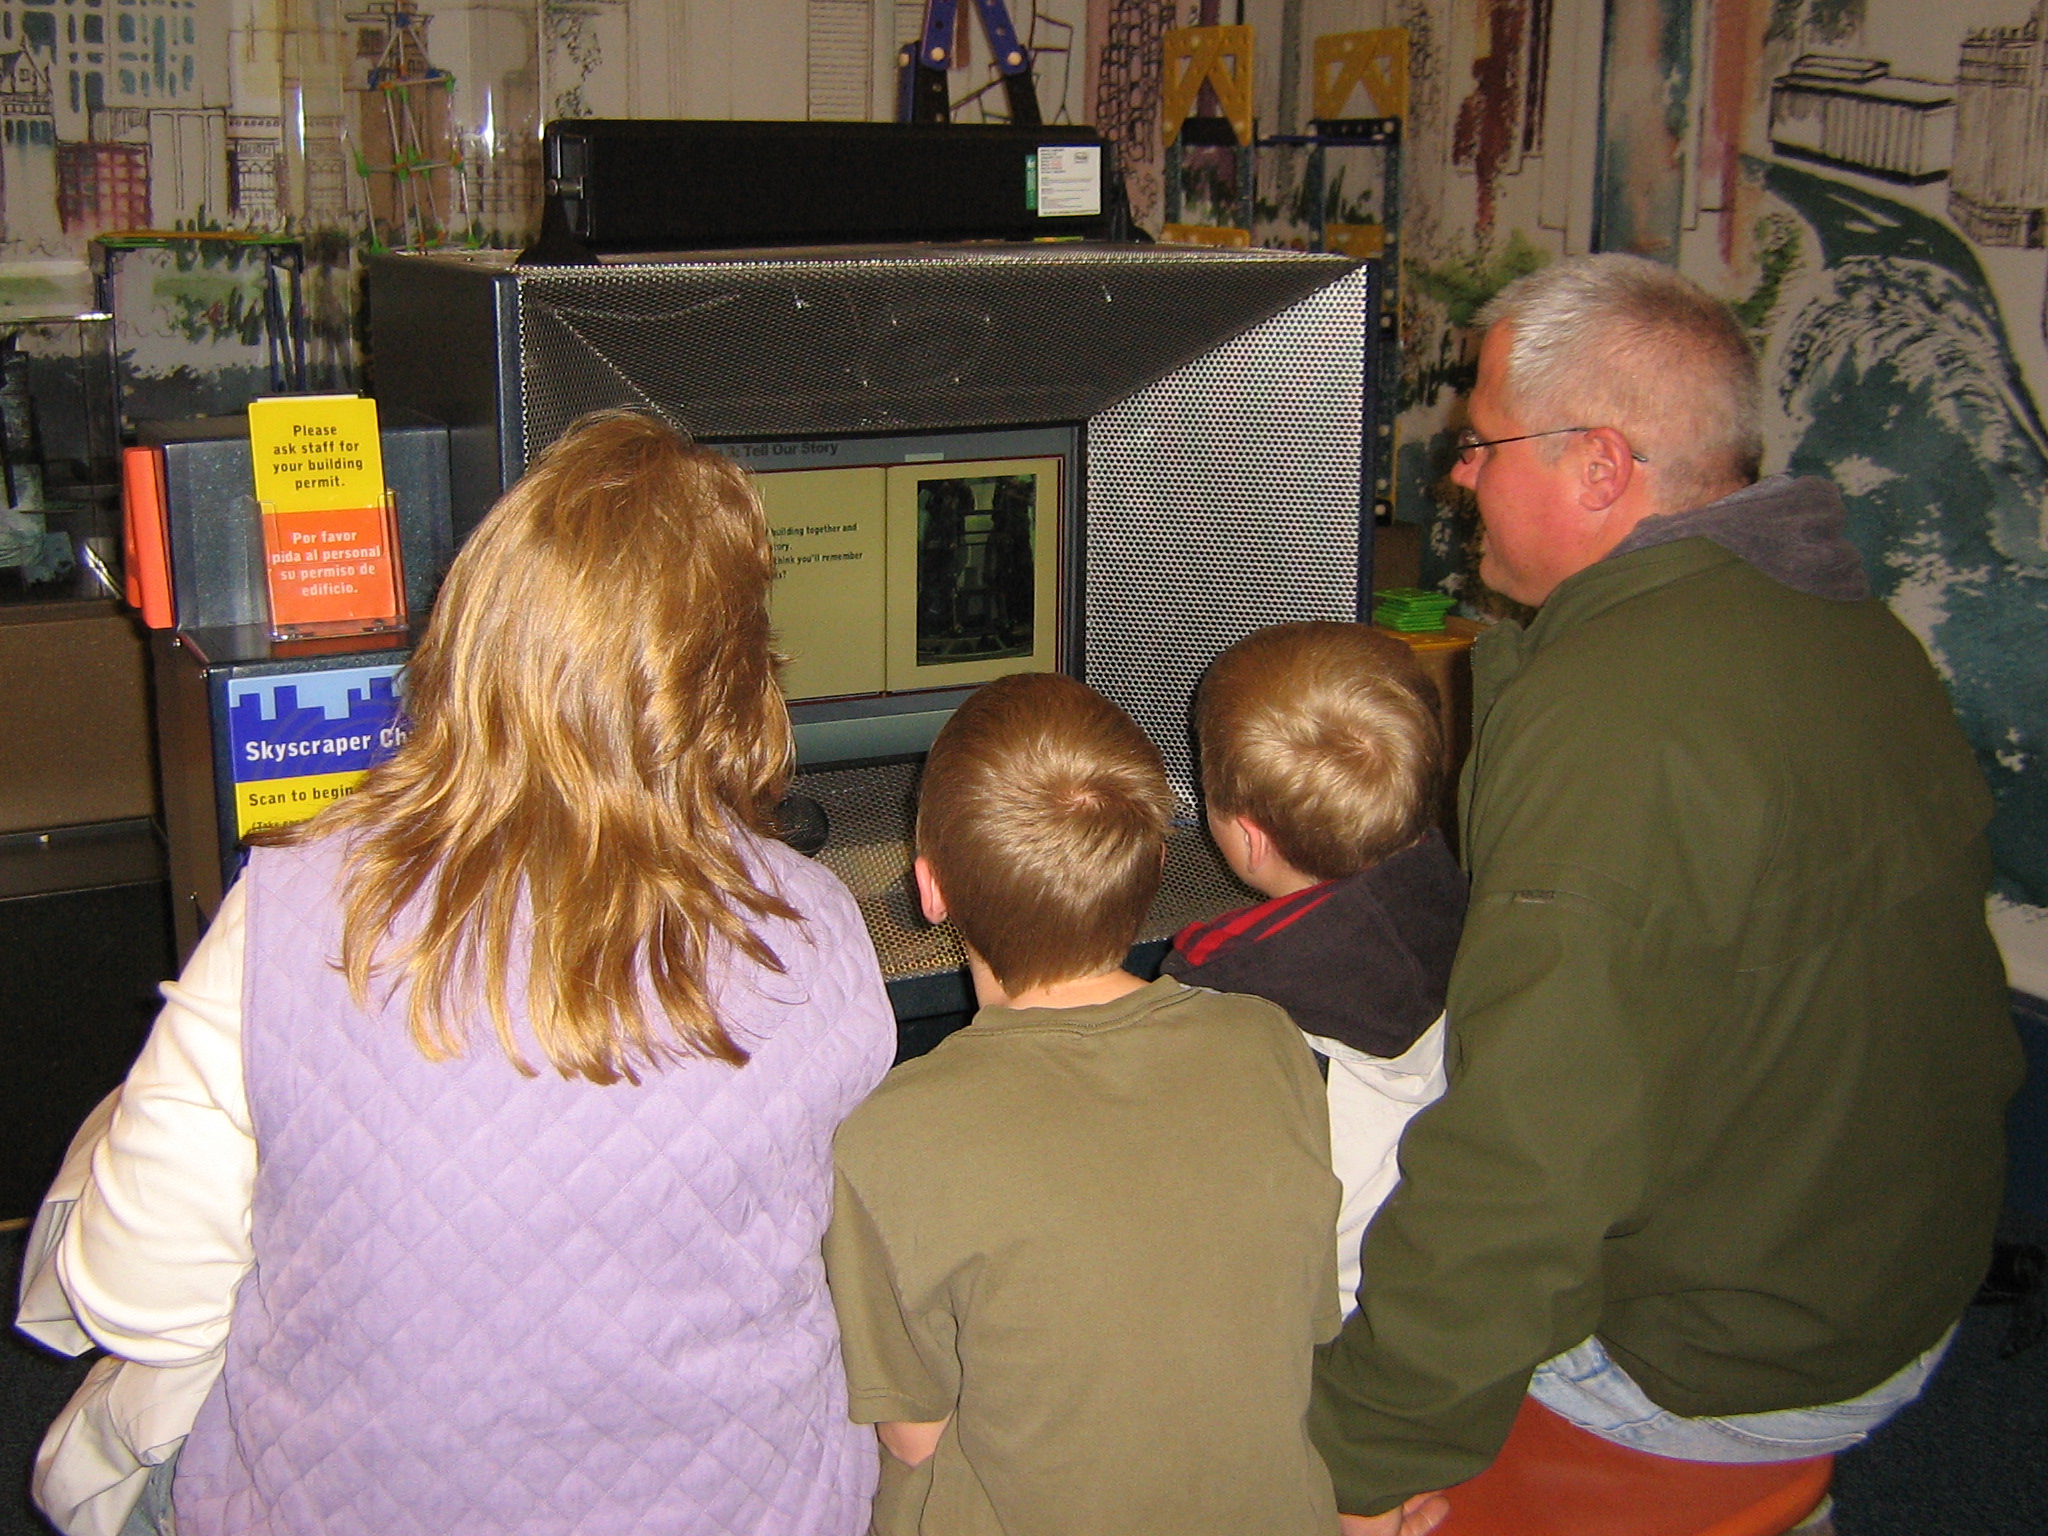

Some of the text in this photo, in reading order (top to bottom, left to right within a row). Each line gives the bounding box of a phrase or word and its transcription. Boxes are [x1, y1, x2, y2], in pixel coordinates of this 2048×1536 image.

[293, 425, 337, 436] Please
[273, 441, 360, 455] ask staff for
[744, 444, 769, 457] Tell
[773, 443, 798, 455] Our
[801, 441, 839, 456] Story
[272, 458, 363, 474] your building
[295, 476, 345, 491] permit.
[806, 524, 841, 535] together
[842, 522, 858, 531] and
[292, 530, 357, 544] Por favor
[272, 546, 381, 565] pida al personal
[797, 554, 820, 564] you'll
[821, 552, 863, 561] remember
[280, 563, 375, 580] su permiso de
[302, 583, 358, 597] edificio.
[245, 733, 372, 761] Skyscraper
[249, 785, 353, 807] Scan to begin
